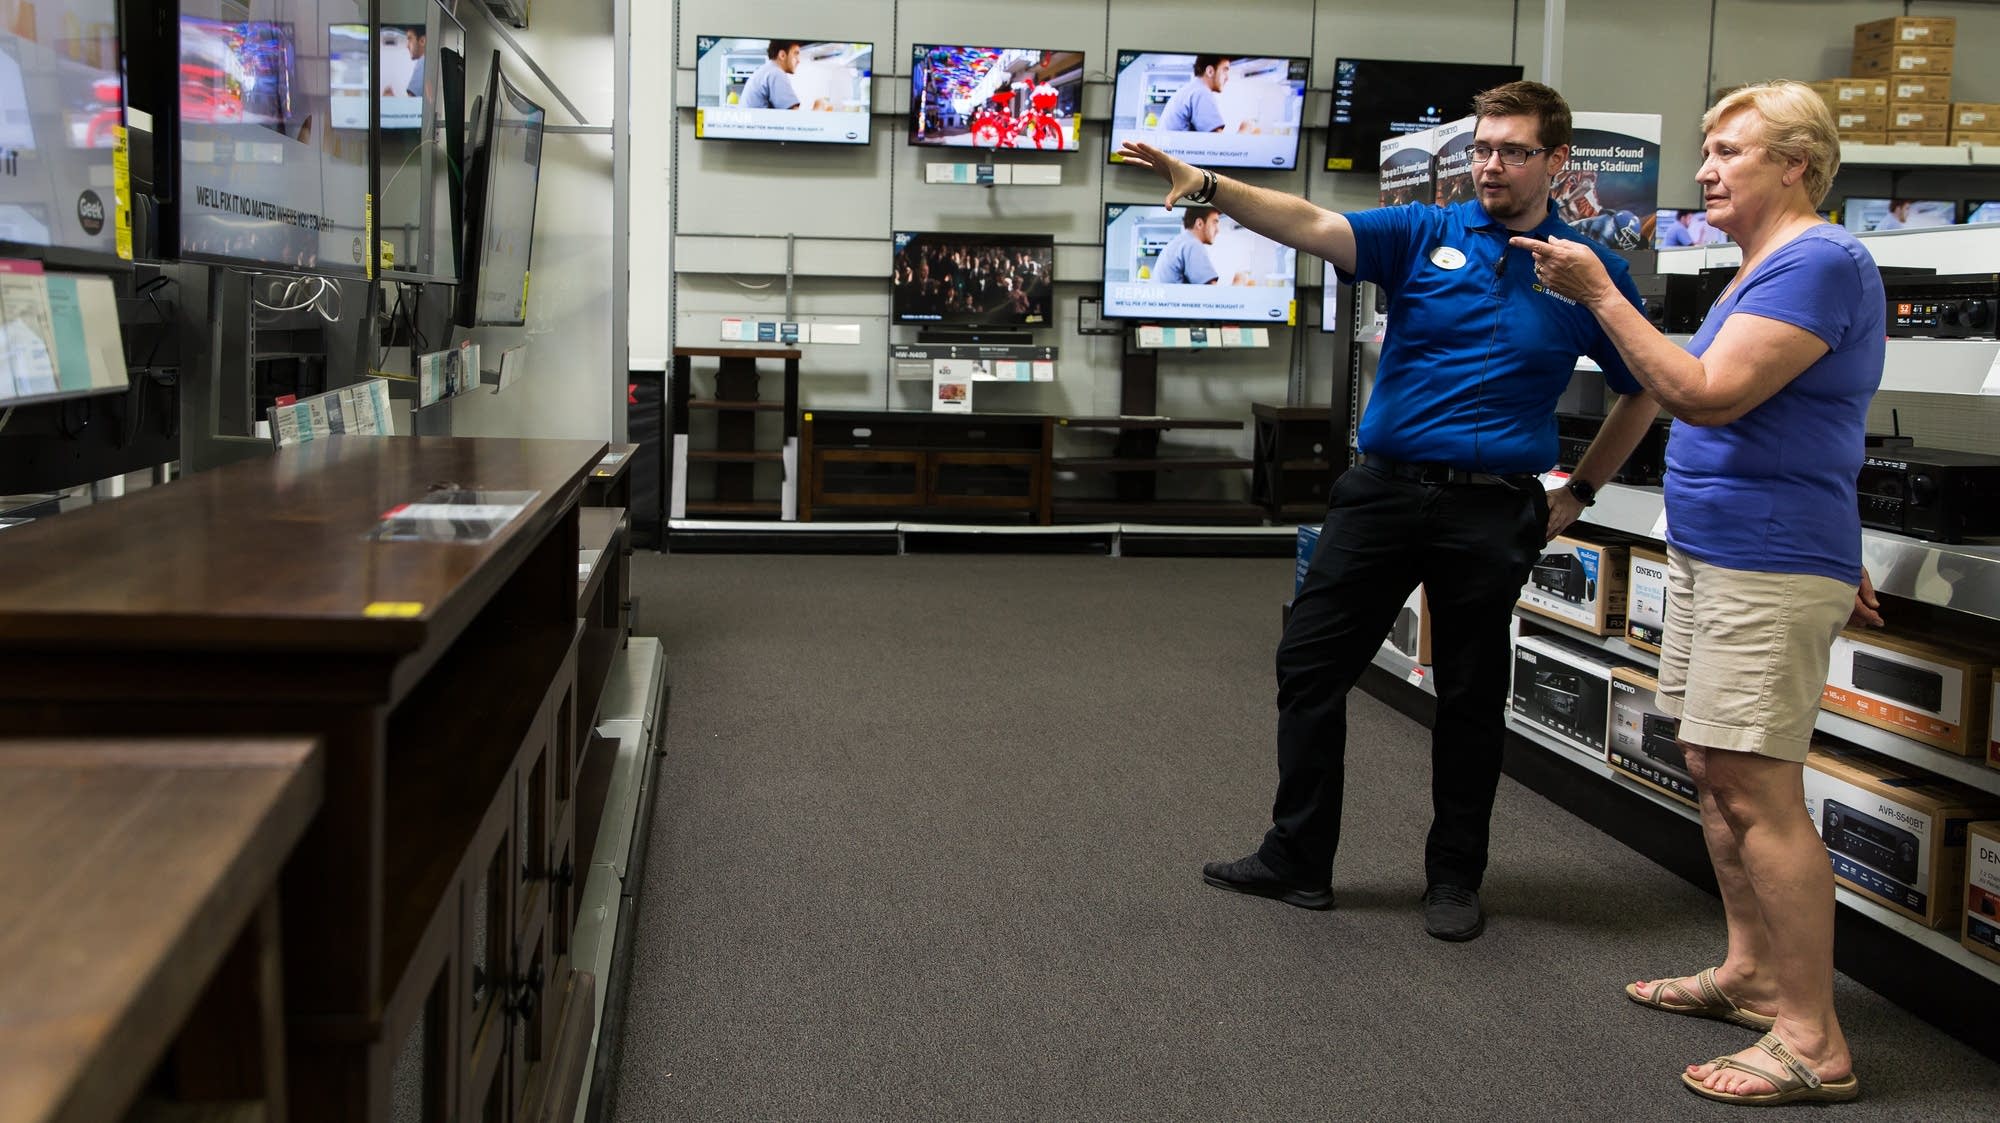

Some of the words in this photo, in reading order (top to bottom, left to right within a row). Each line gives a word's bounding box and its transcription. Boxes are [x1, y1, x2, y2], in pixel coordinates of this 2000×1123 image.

[1571, 145, 1613, 158] Surround
[1615, 147, 1644, 158] Sound
[1571, 160, 1580, 171] in
[1583, 160, 1598, 171] the
[1600, 161, 1643, 173] Stadium!
[80, 198, 103, 219] Geek
[196, 186, 219, 209] WE'LL
[220, 192, 231, 211] FIX
[232, 195, 239, 213] IT
[240, 197, 251, 217] NO
[252, 199, 276, 221] MATTER
[277, 205, 297, 226] WHERE
[1115, 287, 1166, 300] REPAIR
[1545, 288, 1577, 306] SAMSUNG
[1635, 565, 1662, 579] ONKYO
[1613, 681, 1635, 694] ONKYO
[1878, 805, 1924, 830] AVR-S540BT
